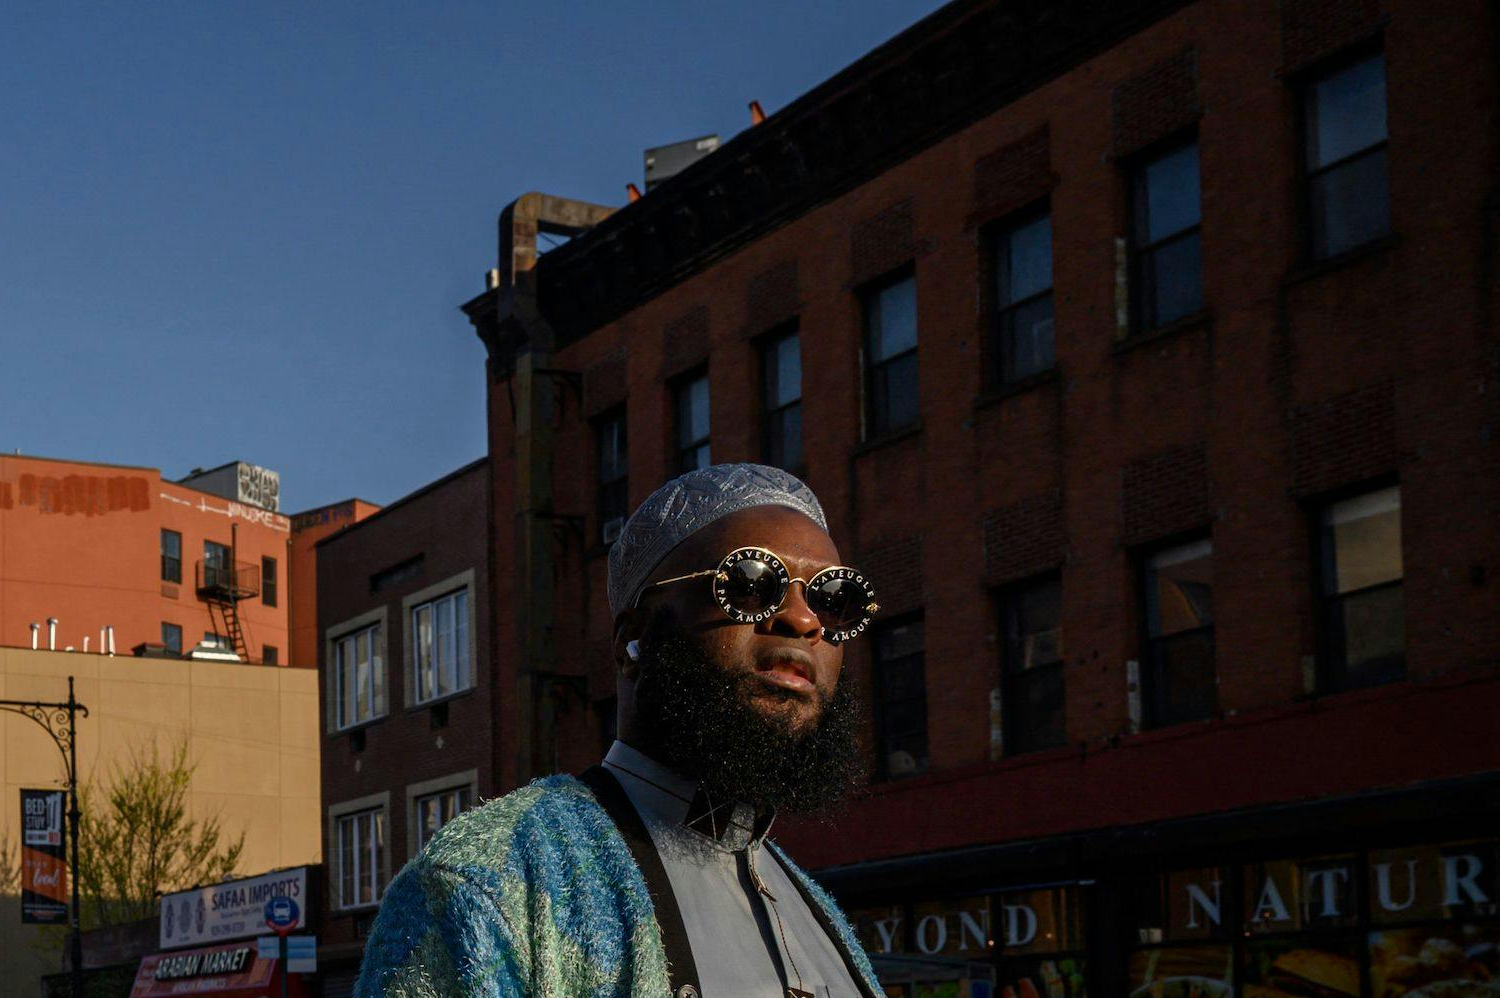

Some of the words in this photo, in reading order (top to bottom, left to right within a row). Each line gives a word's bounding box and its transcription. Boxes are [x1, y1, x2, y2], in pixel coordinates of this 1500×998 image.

[725, 550, 789, 584] L'AVEUGLE
[811, 570, 875, 598] L'AVEUGLE
[717, 589, 731, 613] PAR
[736, 604, 779, 623] AMOUR
[832, 616, 871, 642] AMOUR
[211, 888, 246, 911] SAFAA
[249, 877, 300, 906] IMPORTS
[155, 954, 199, 979] ARABIAN
[201, 947, 251, 974] MARKET
